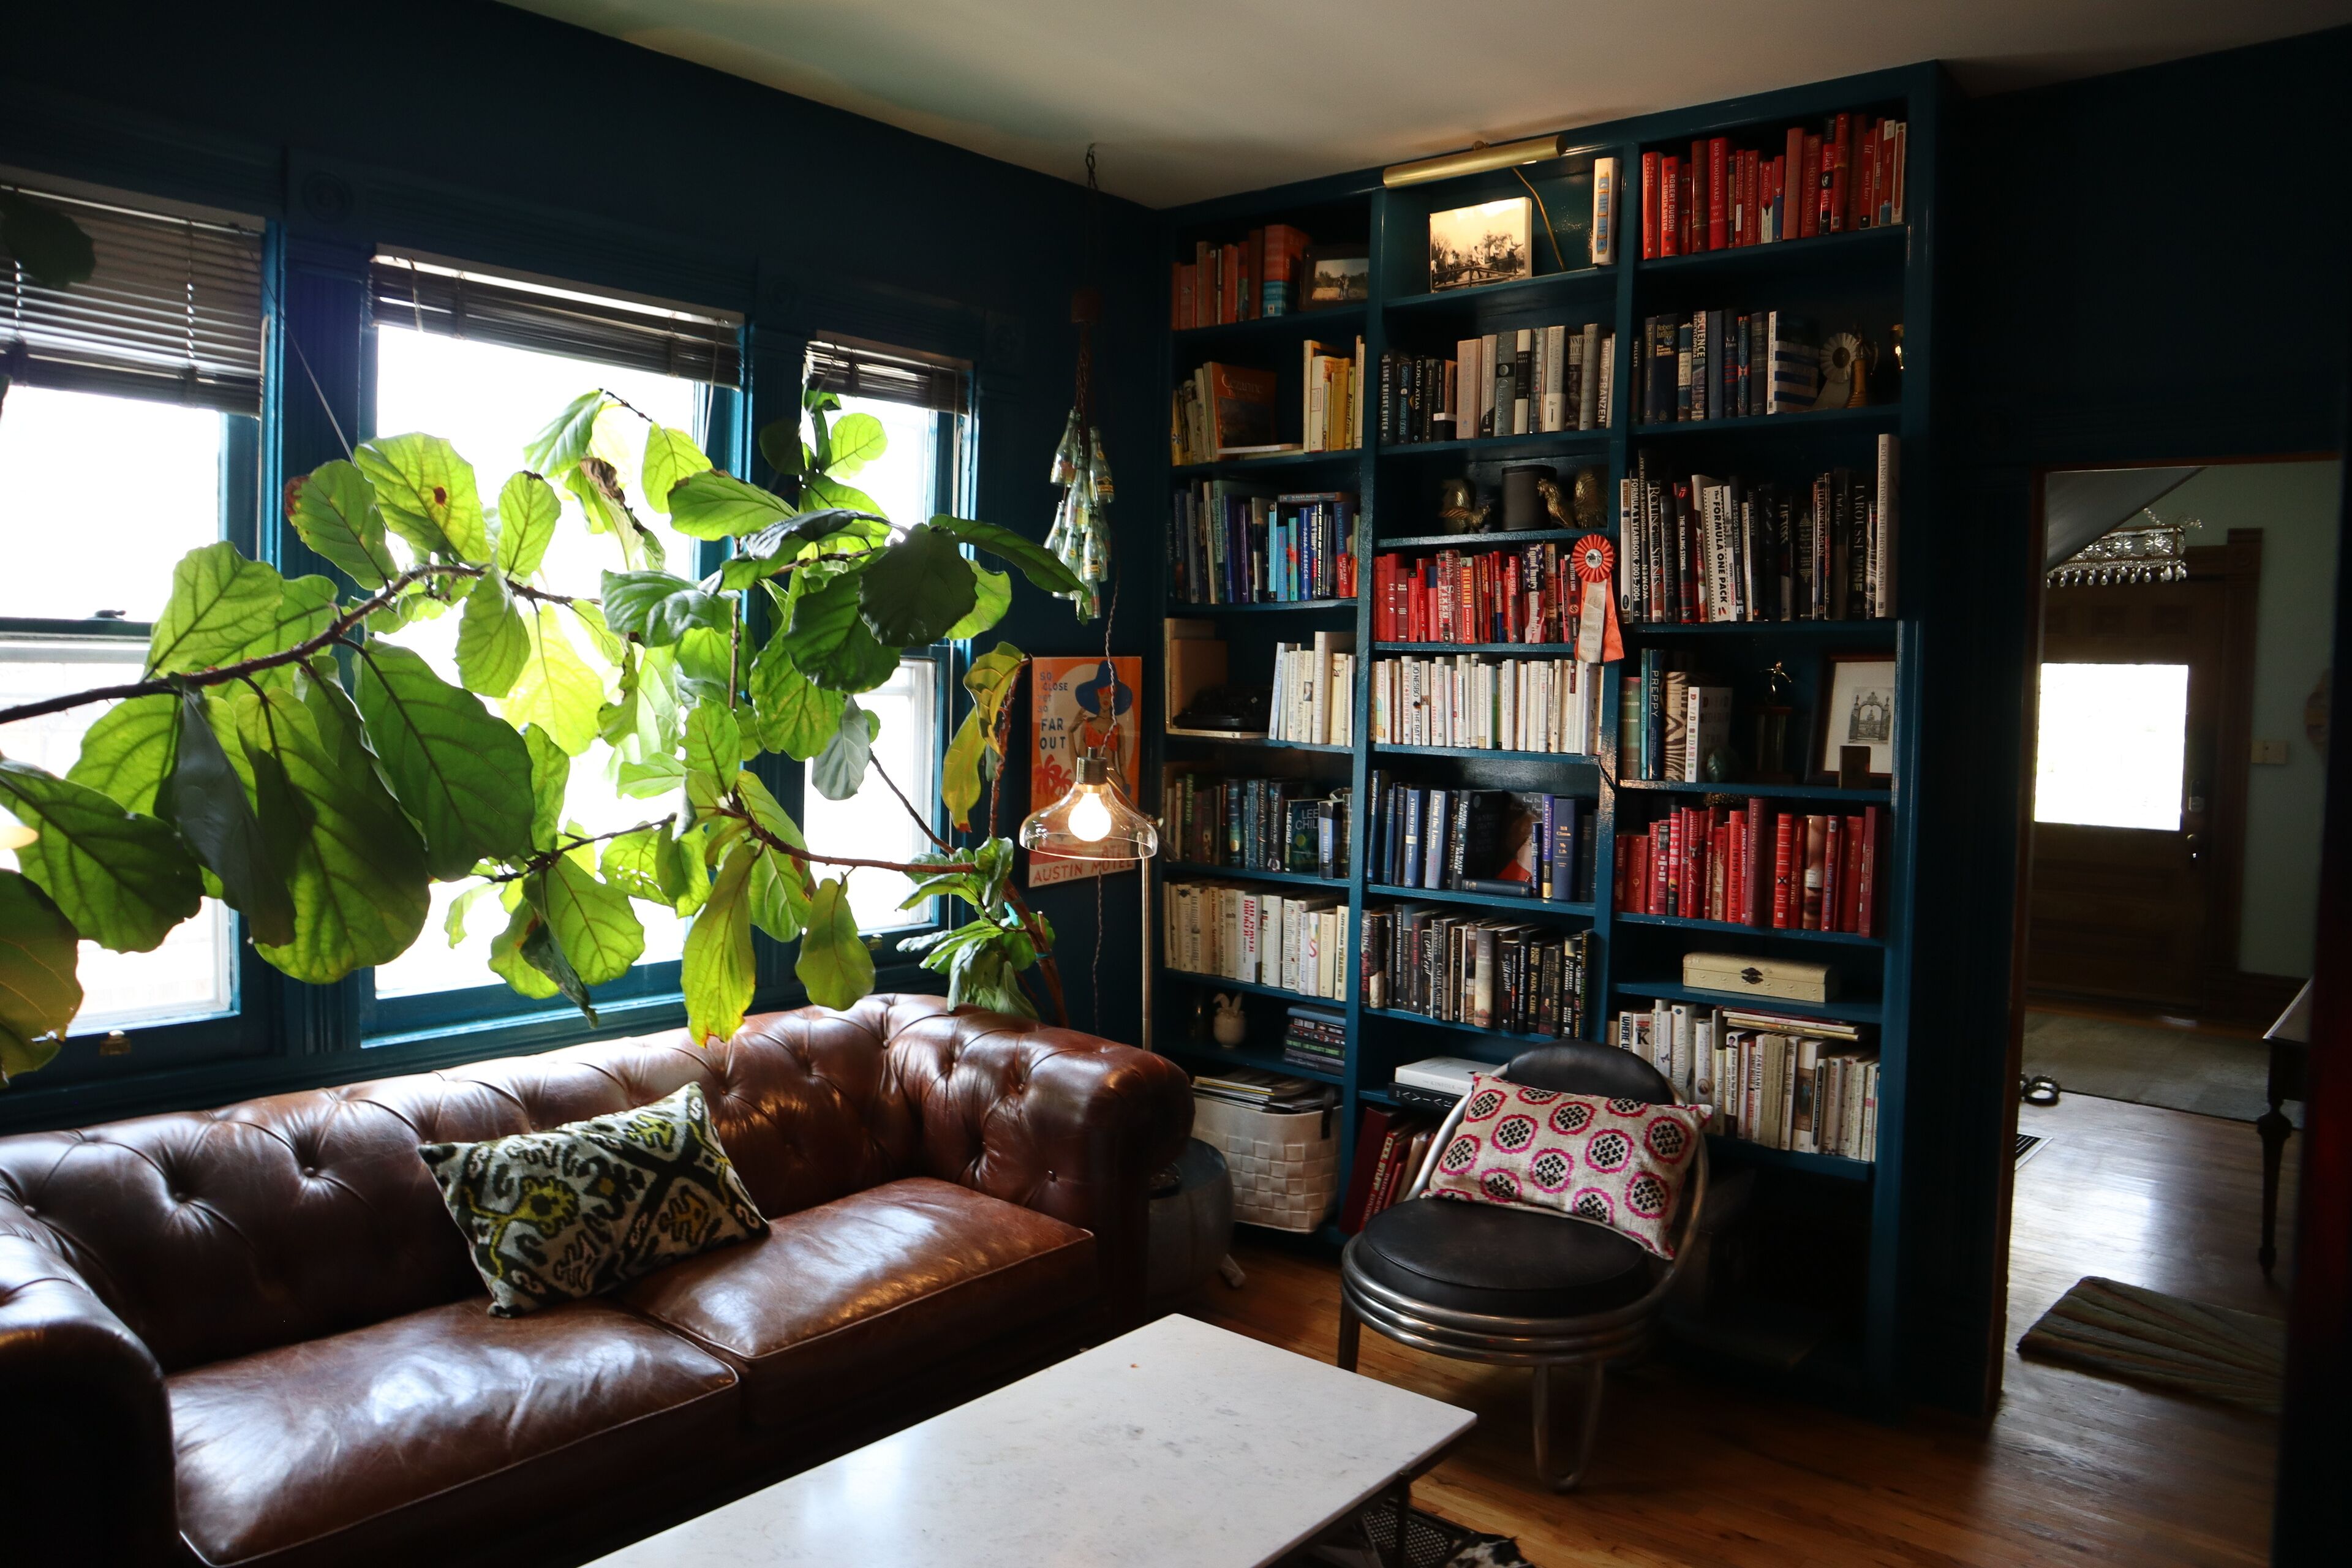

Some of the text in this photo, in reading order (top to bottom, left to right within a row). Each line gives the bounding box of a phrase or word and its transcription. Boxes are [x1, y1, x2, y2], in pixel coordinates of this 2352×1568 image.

[1864, 145, 1873, 153] lit
[1806, 187, 1815, 224] PYRAMID
[1597, 376, 1607, 422] FRANZEN
[1649, 487, 1660, 532] ROLLING
[1779, 505, 1789, 544] LIFTOFF
[1852, 485, 1865, 592] LAROUSSE WINE
[1713, 502, 1723, 551] FORMULA
[1719, 577, 1728, 603] PACK
[1528, 564, 1539, 590] Clancy
[1651, 548, 1662, 586] STONES
[1463, 569, 1471, 604] DREAMLAND
[1042, 682, 1068, 691] CLOSE
[1041, 718, 1064, 731] FAR
[1039, 736, 1066, 750] OUT
[1302, 809, 1319, 819] LEE
[1433, 794, 1441, 816] Facing
[1033, 859, 1133, 884] AUSTIN MOTEL
[1362, 919, 1371, 946] VIOLIN
[1637, 1032, 1649, 1045] K
[1380, 1136, 1392, 1161] COOL
[1371, 1161, 1386, 1191] STUFF
